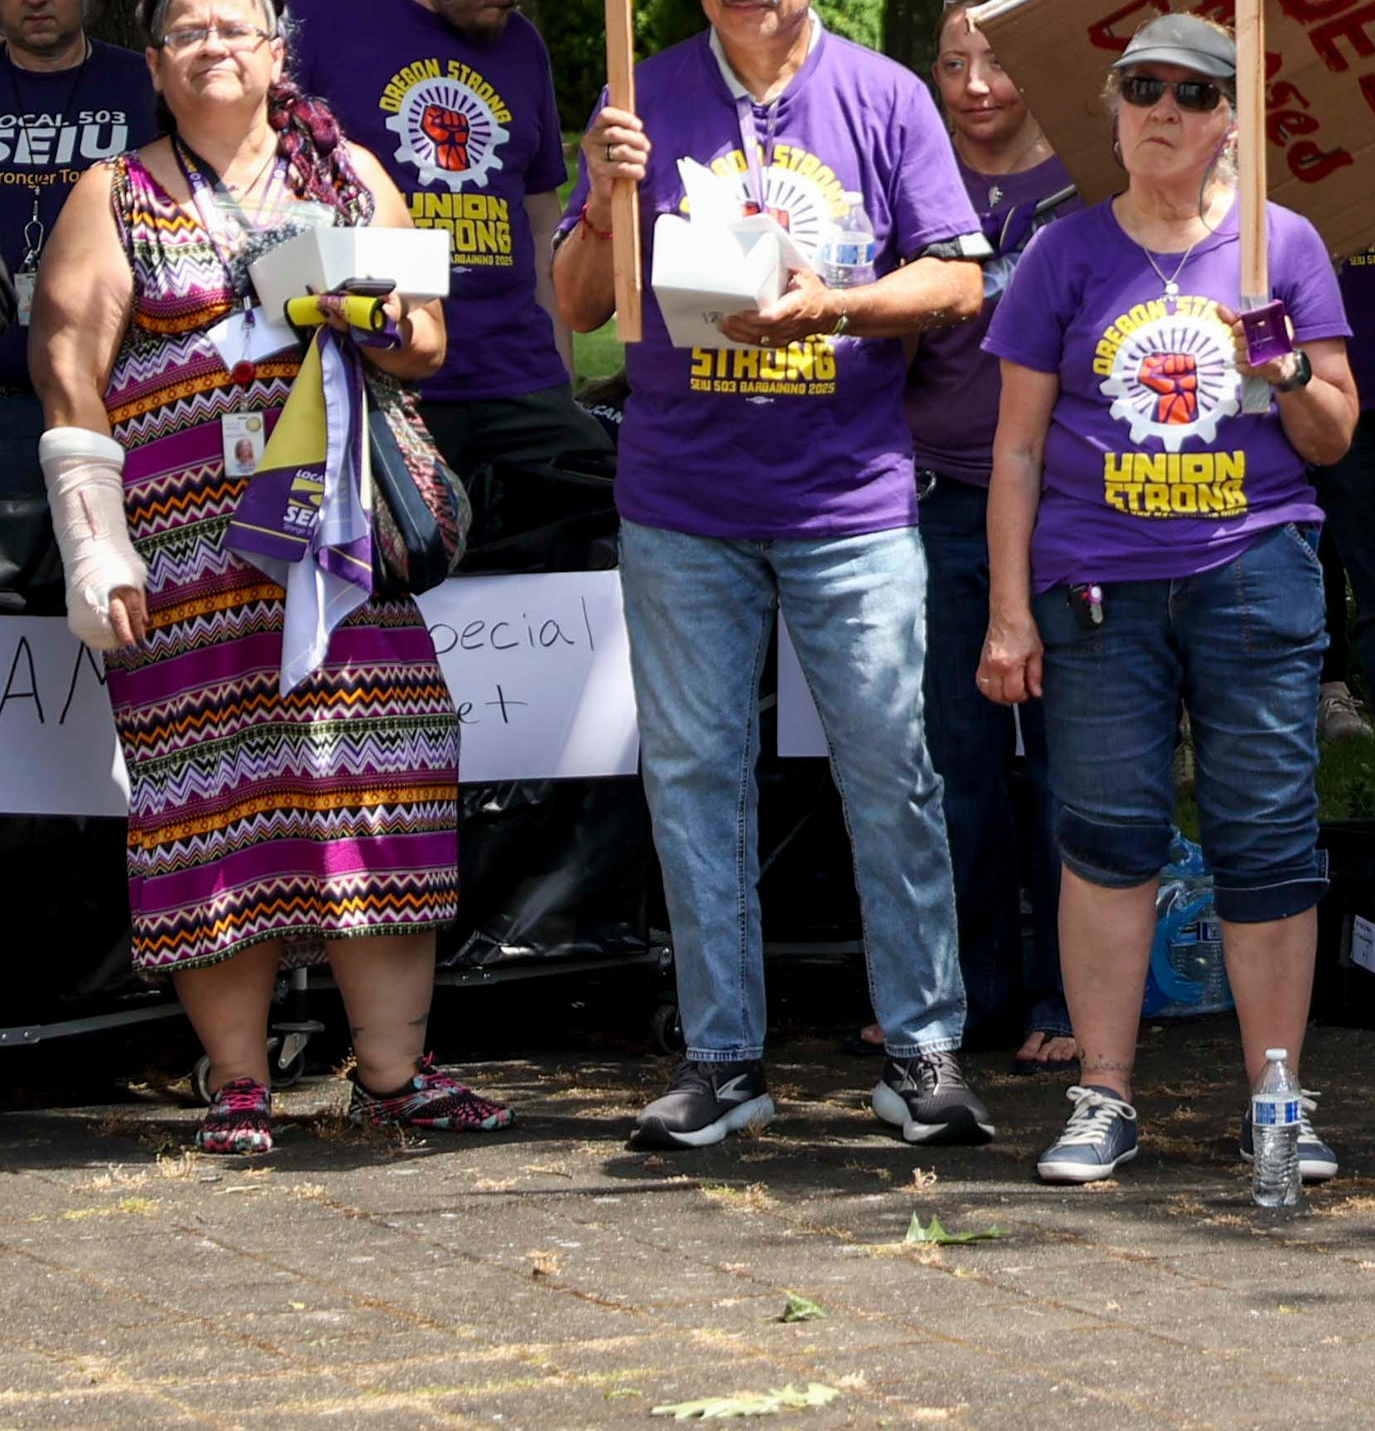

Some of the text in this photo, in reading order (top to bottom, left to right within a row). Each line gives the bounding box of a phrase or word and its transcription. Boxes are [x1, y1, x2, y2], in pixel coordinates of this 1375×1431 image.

[378, 58, 513, 124] OREGON STRONG
[0, 110, 126, 127] OCAL 503
[690, 378, 836, 395] SEIU 503 BARGAINING 2025
[296, 469, 325, 482] LOCA
[1104, 450, 1246, 483] UNION
[1105, 481, 1248, 512] STRONG
[283, 506, 318, 527] SEI
